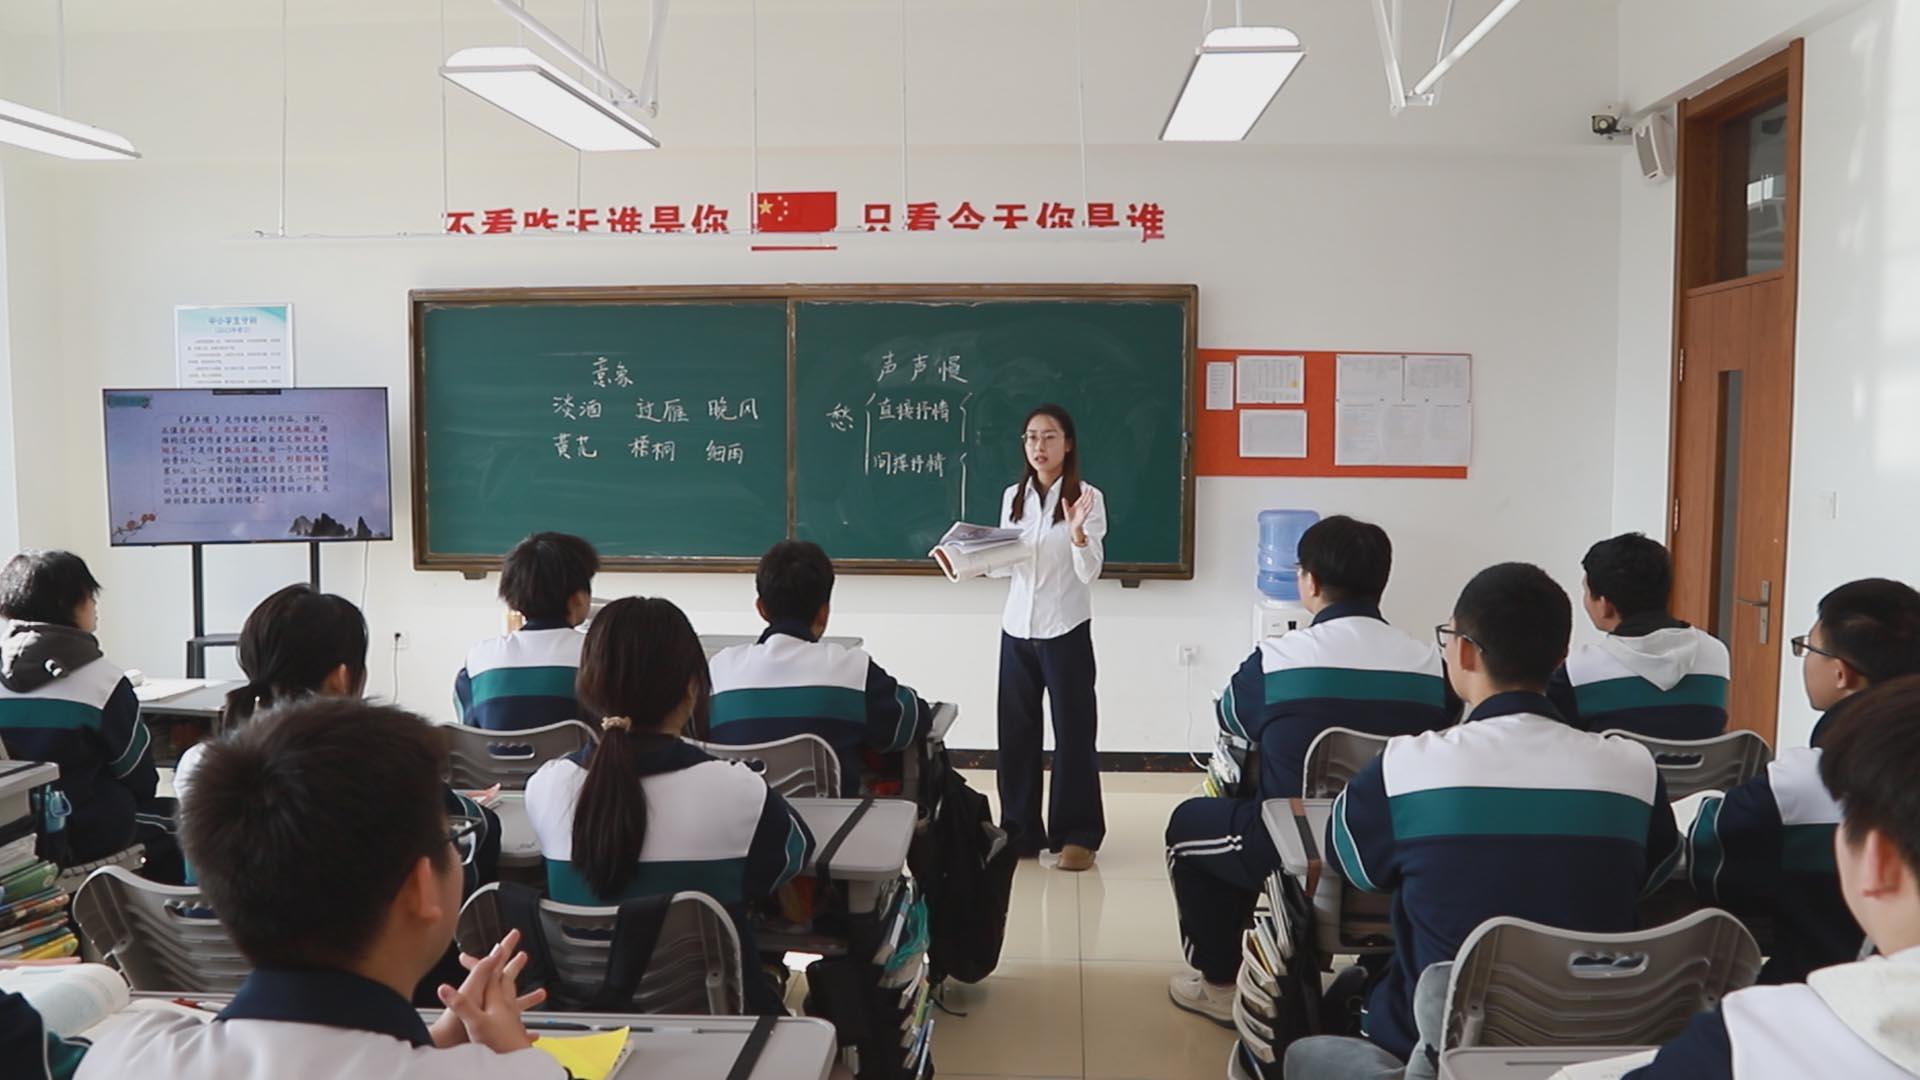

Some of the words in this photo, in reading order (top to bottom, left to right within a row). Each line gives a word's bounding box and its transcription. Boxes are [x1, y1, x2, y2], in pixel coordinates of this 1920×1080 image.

[446, 204, 729, 234] 不看昨天谁是你
[864, 201, 1165, 242] 只看今天你是谁
[592, 356, 634, 388] 意象
[877, 351, 968, 384] 声声慢
[552, 393, 603, 421] 淡酒
[635, 397, 690, 423] 过雁
[708, 396, 759, 421] 晚风
[825, 402, 854, 432] 愁
[877, 398, 950, 423] 直接抒情
[628, 435, 676, 462] 梧桐
[706, 439, 744, 465] 细雨
[872, 452, 946, 478] 间接抒情
